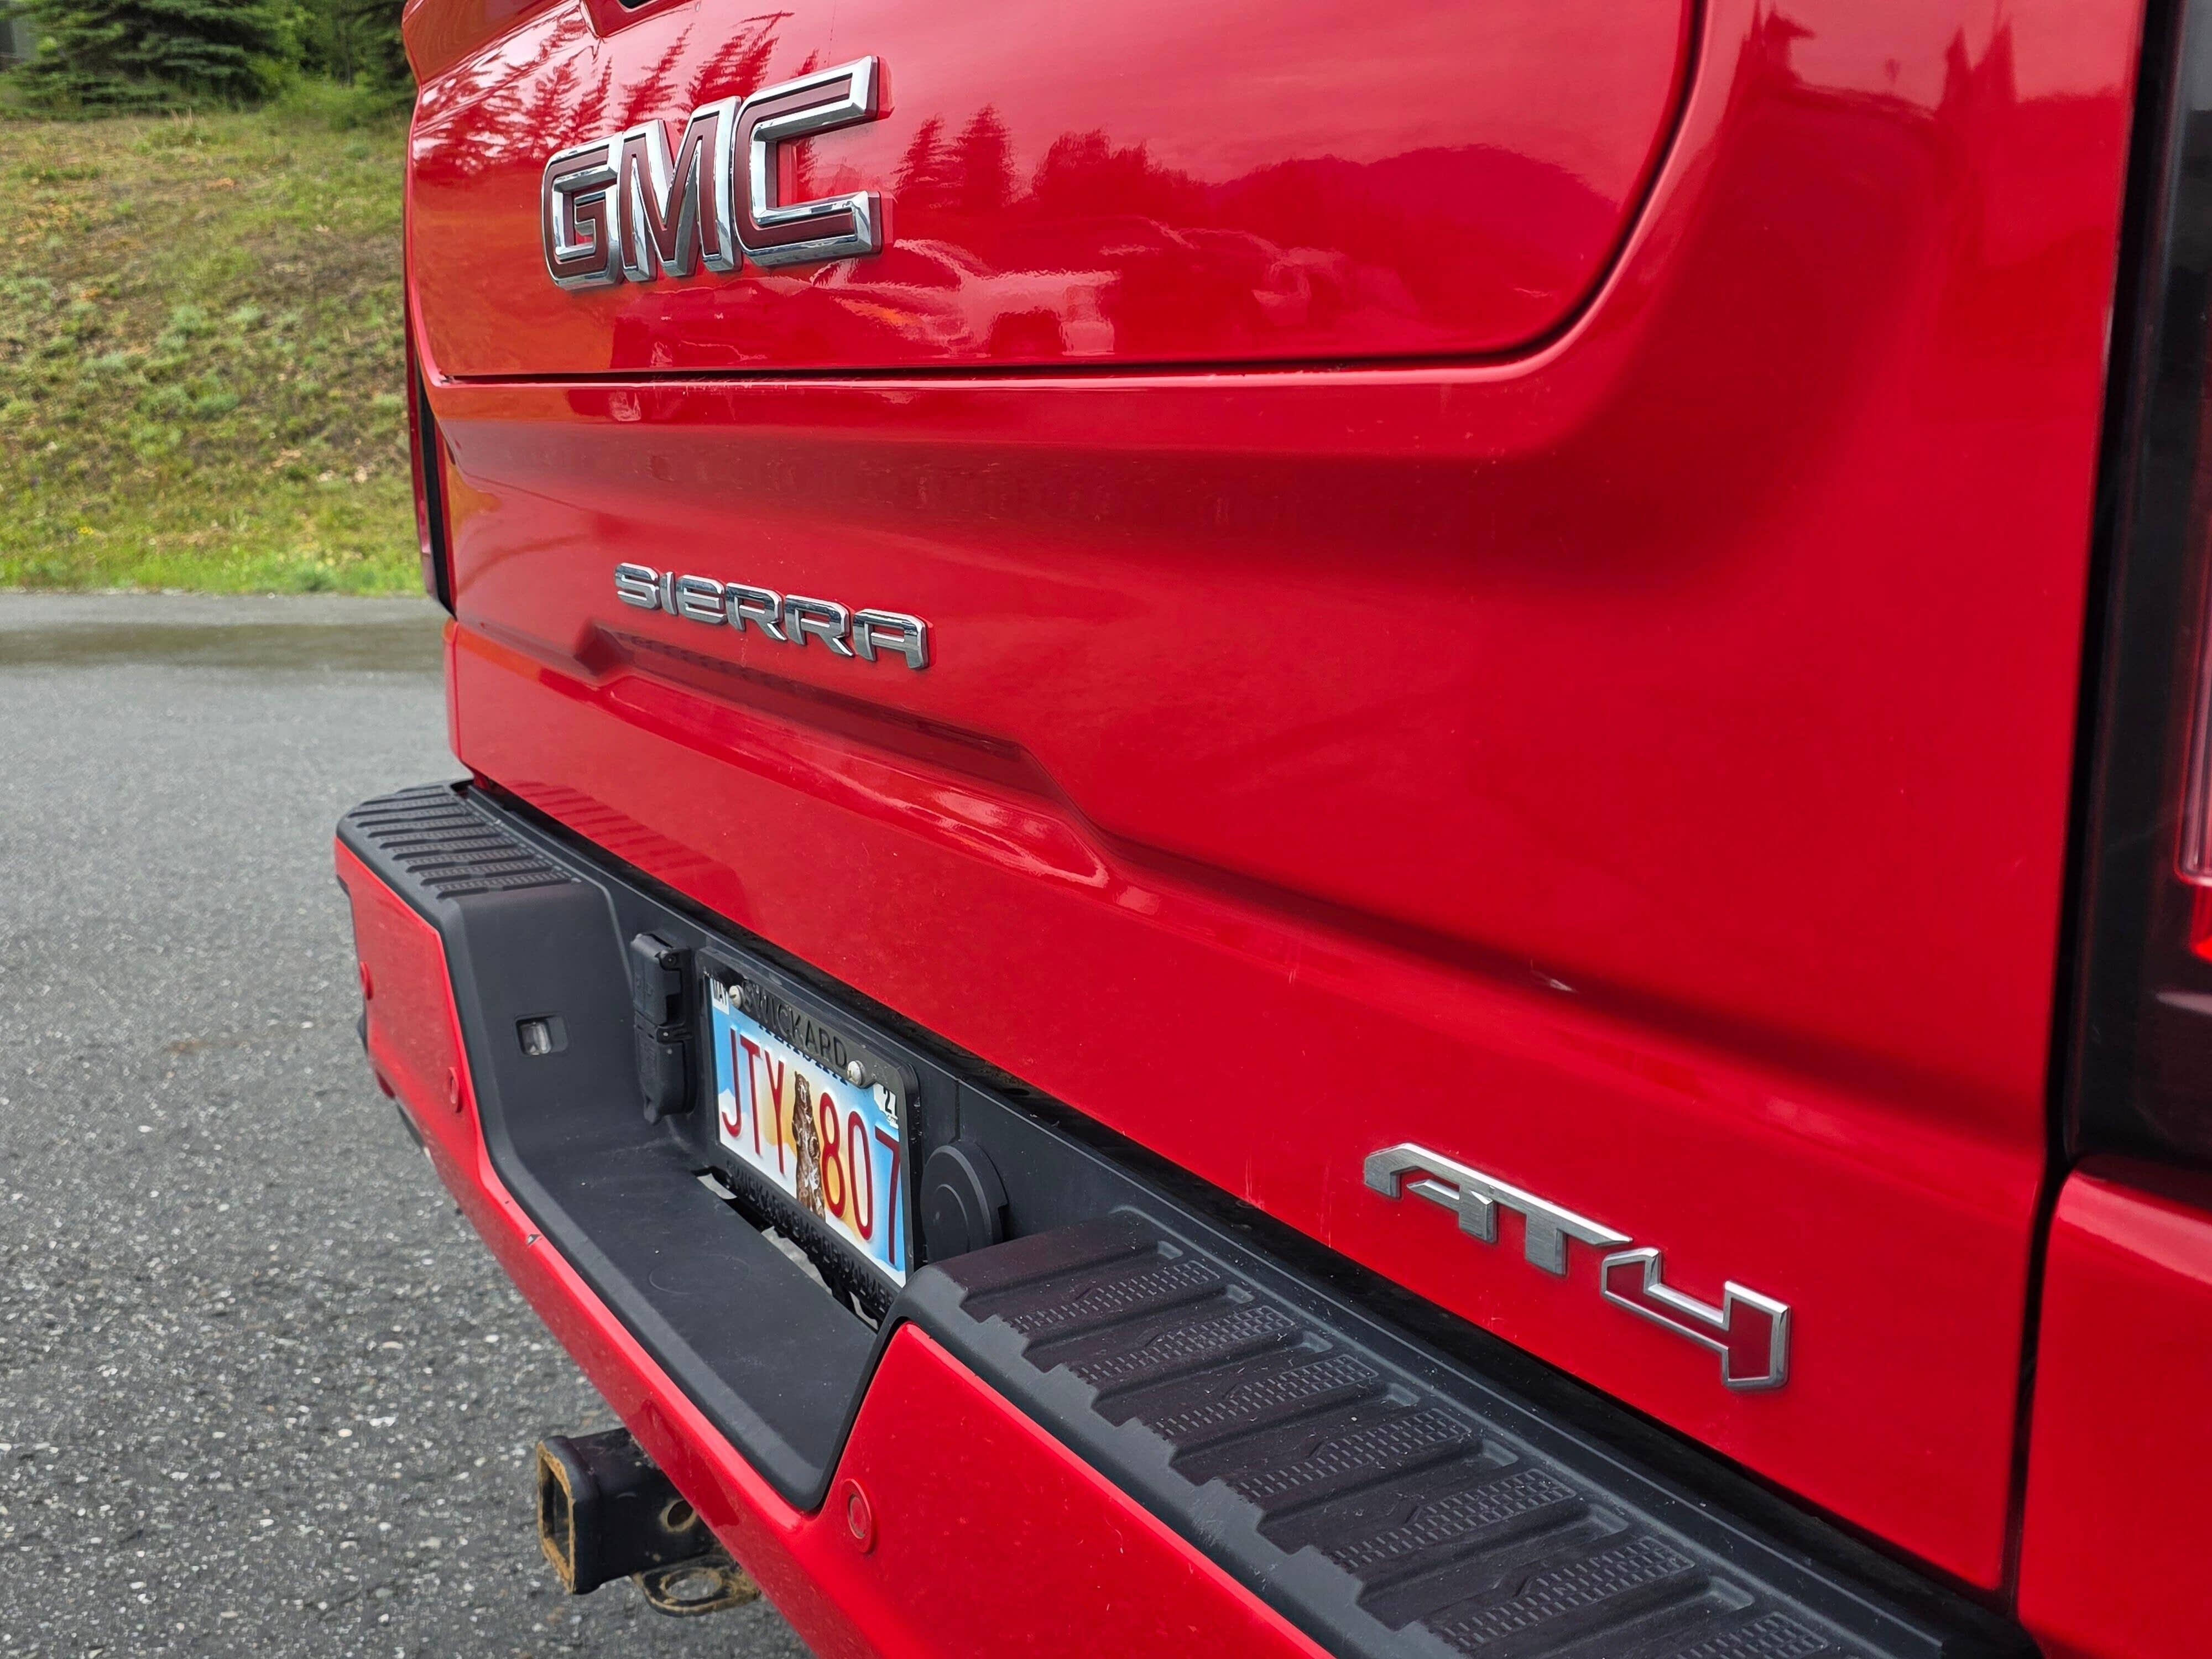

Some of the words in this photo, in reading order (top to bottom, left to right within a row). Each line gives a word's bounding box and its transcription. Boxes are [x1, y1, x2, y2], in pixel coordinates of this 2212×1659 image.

[541, 55, 883, 291] GMC
[614, 562, 930, 670] SIERRA
[742, 980, 847, 1069] SWICKARD
[722, 1027, 785, 1174] JTY
[820, 1092, 900, 1265] 807
[1364, 1142, 1791, 1391] AT4
